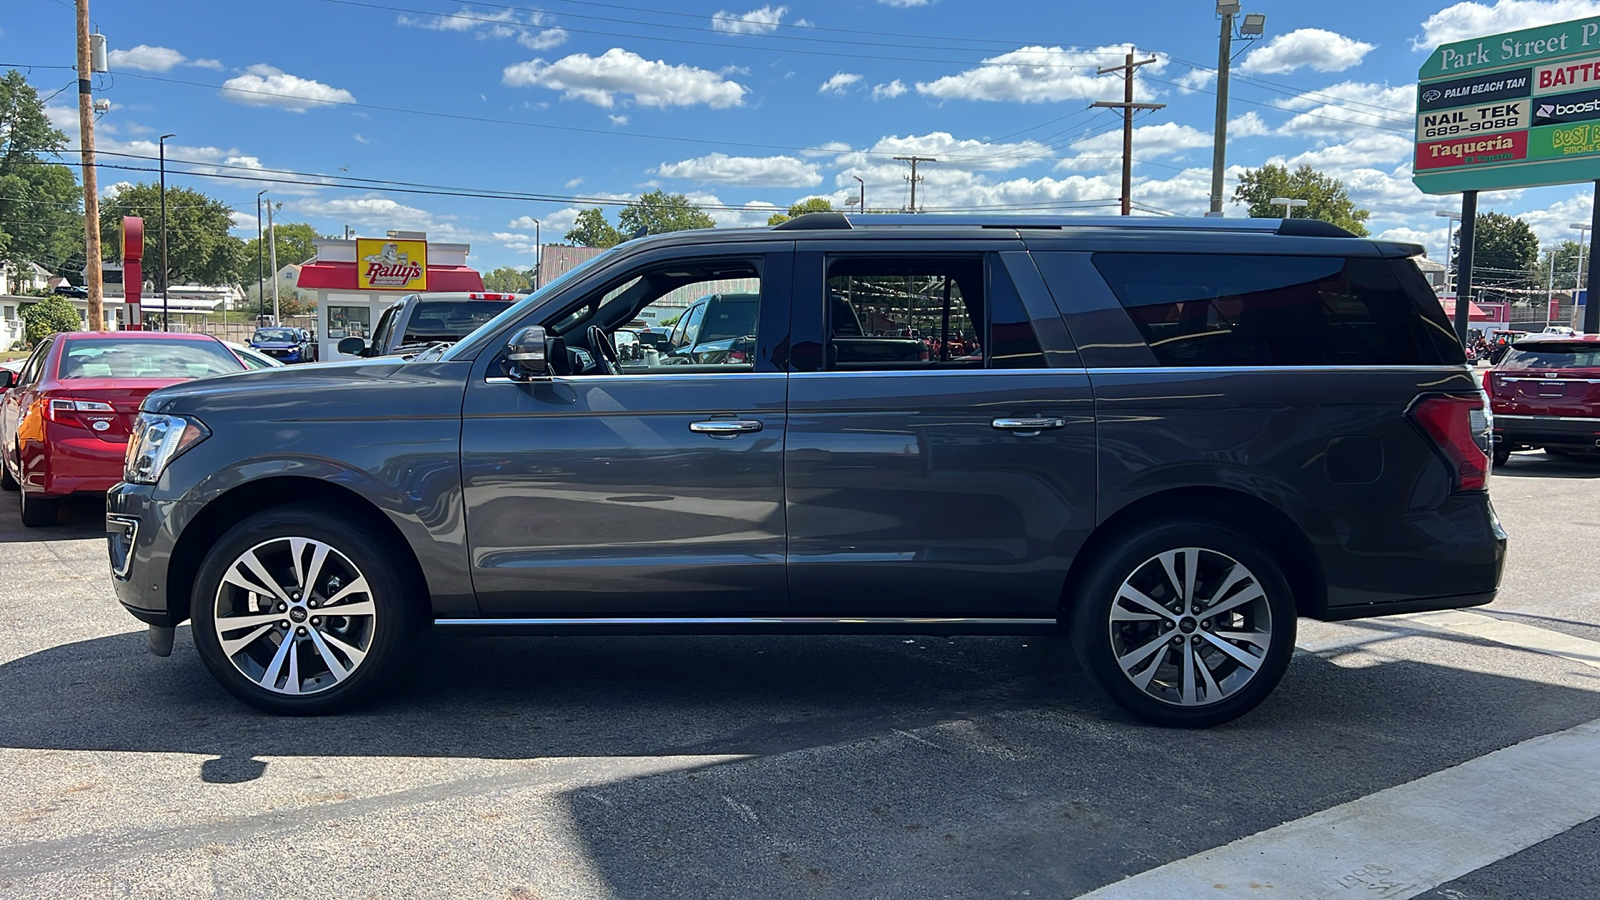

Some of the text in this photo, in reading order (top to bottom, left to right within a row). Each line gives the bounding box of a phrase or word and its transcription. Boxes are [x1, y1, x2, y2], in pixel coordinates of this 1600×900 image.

[1440, 23, 1600, 70] Park Street P
[1444, 77, 1526, 98] PALM BEACH TAN
[1424, 103, 1520, 127] NAIL TEK
[1556, 99, 1600, 116] boost
[1426, 117, 1519, 137] 689-9088
[365, 261, 422, 285] Rally's
